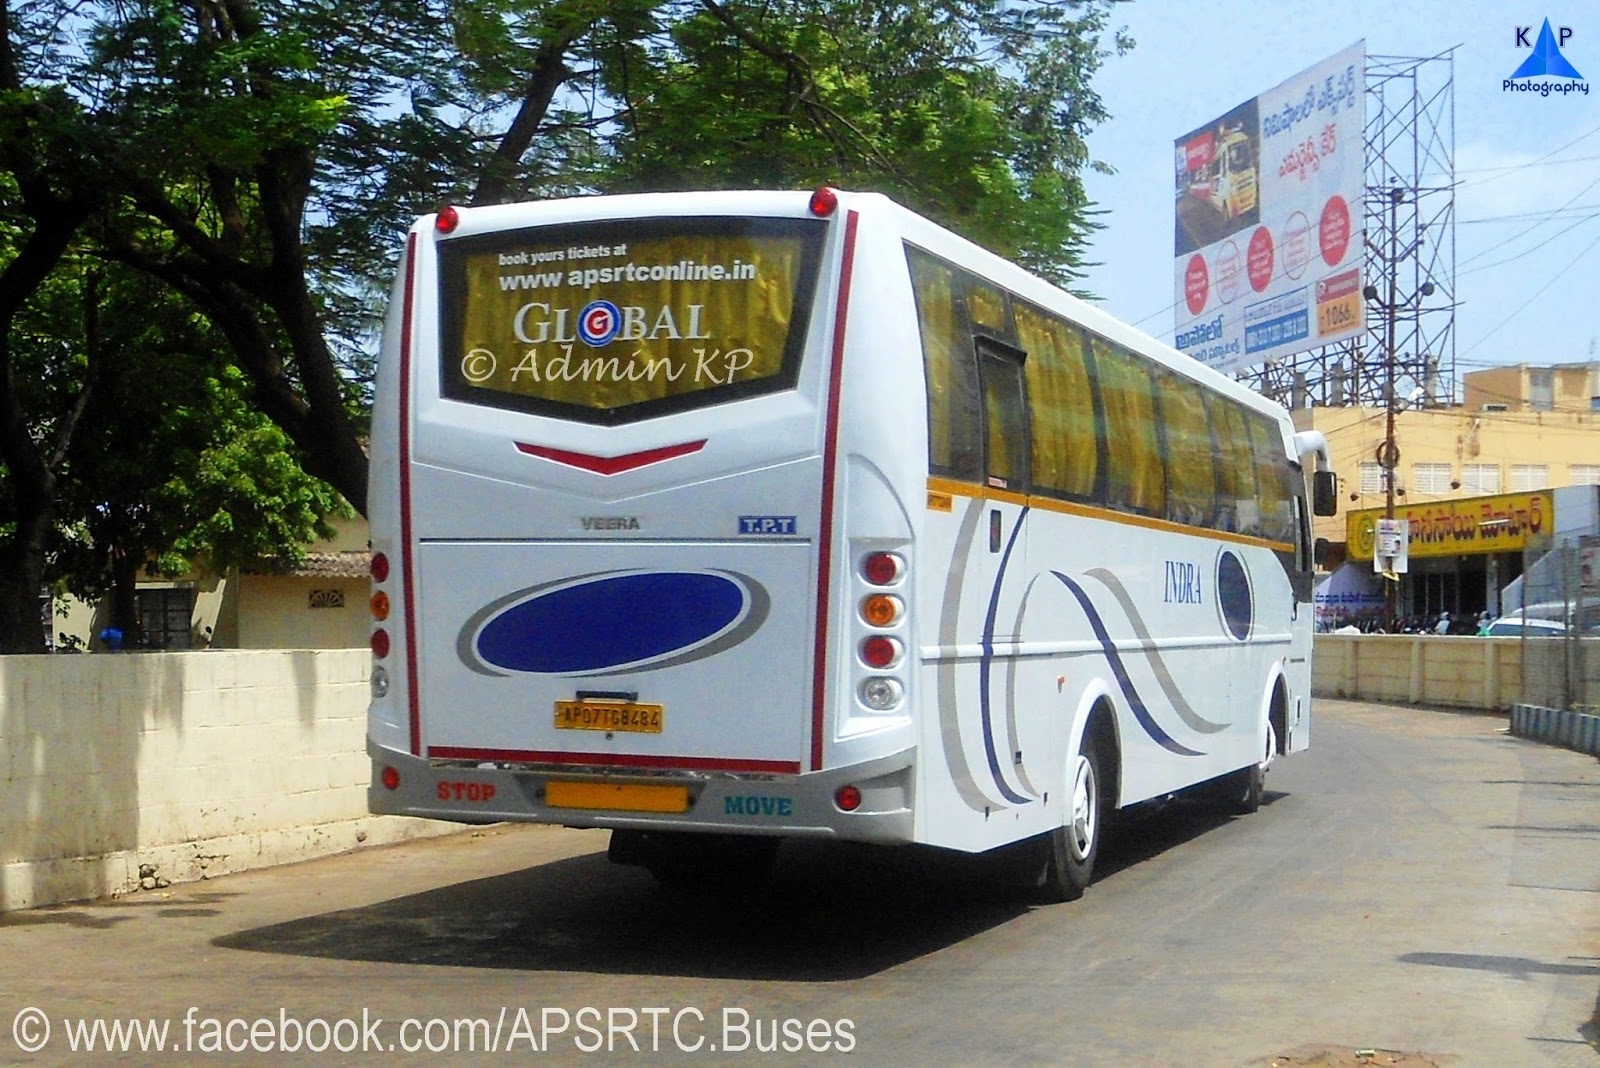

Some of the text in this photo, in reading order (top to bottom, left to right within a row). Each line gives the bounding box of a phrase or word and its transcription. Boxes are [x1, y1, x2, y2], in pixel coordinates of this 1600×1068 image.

[499, 244, 627, 267] book yours tickets at
[499, 258, 756, 291] www apsrtconline.in
[581, 518, 640, 531] VEERA
[742, 518, 794, 533] T.P.T
[1164, 560, 1202, 605] INDRA
[437, 780, 496, 802] STOP
[724, 796, 793, 817] MOVE
